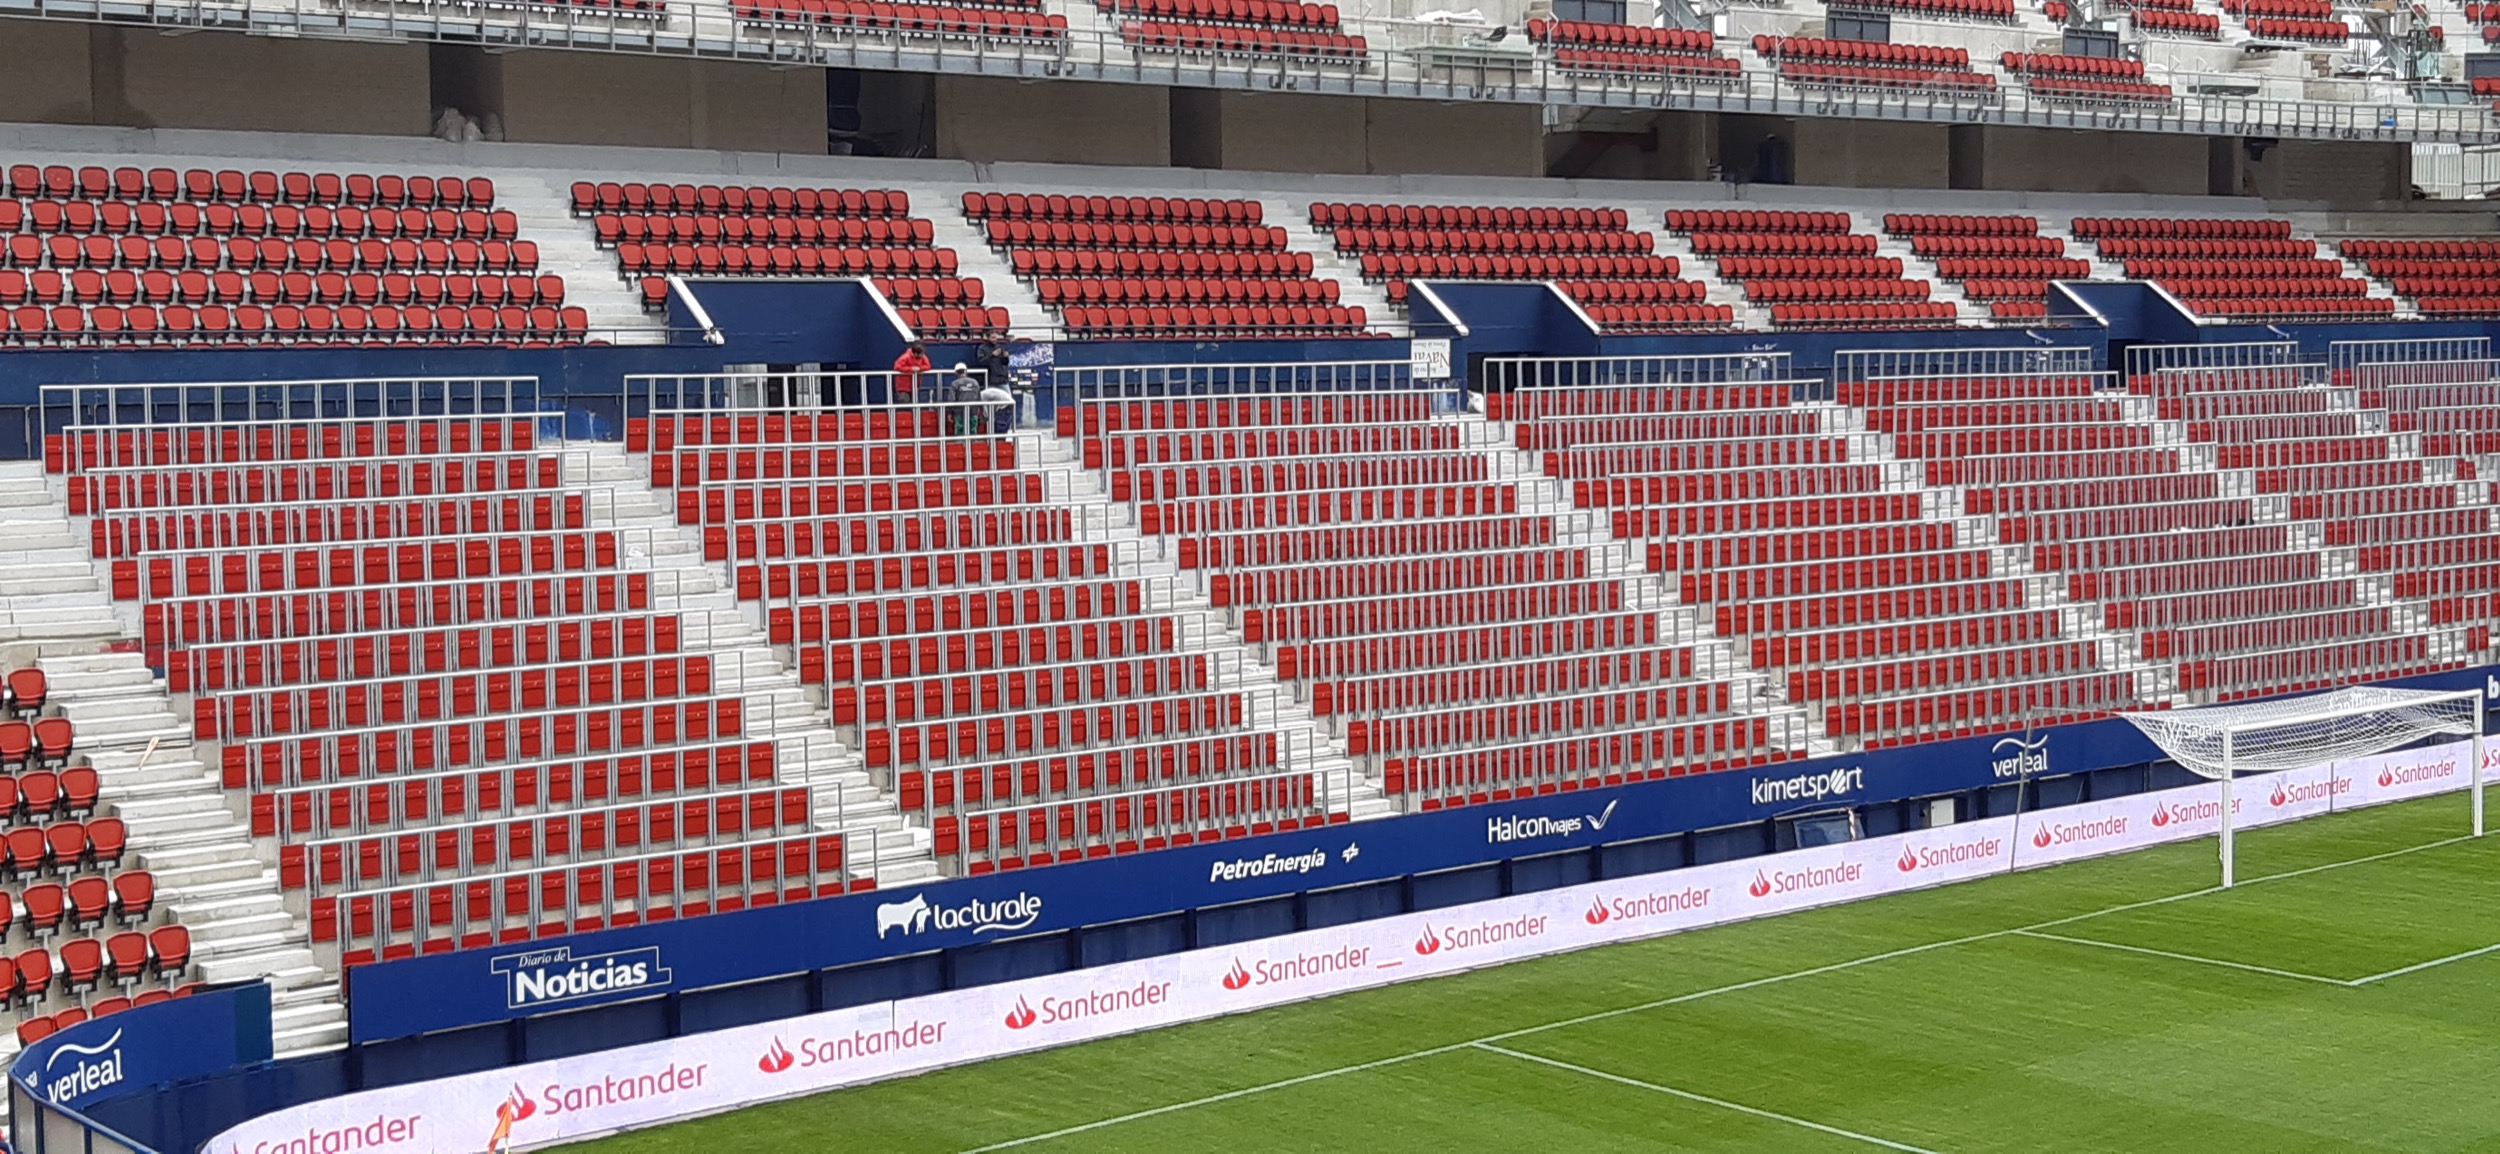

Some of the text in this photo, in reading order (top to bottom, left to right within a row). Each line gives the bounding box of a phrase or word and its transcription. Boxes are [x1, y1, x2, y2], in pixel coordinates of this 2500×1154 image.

[1992, 747, 2048, 778] verleal
[2395, 761, 2456, 783] Santander
[1751, 766, 1863, 805] kimetsport
[2288, 778, 2351, 803] Santander
[2171, 799, 2242, 824] Santaner
[2053, 817, 2128, 845] Santander
[1210, 848, 1325, 883] PetroEnergía
[1920, 838, 2001, 869] Santander
[1774, 862, 1862, 894] Santander
[934, 891, 1042, 935] lacturale
[1612, 887, 1711, 922] Santander
[1443, 915, 1547, 951] Santander
[518, 948, 567, 968] Diario de
[1255, 946, 1370, 985] Santander
[516, 957, 648, 1003] Noticias
[1042, 981, 1171, 1024] Santander
[799, 1020, 947, 1068] Santander
[46, 1048, 123, 1104] verleal
[543, 1063, 708, 1116] Santander
